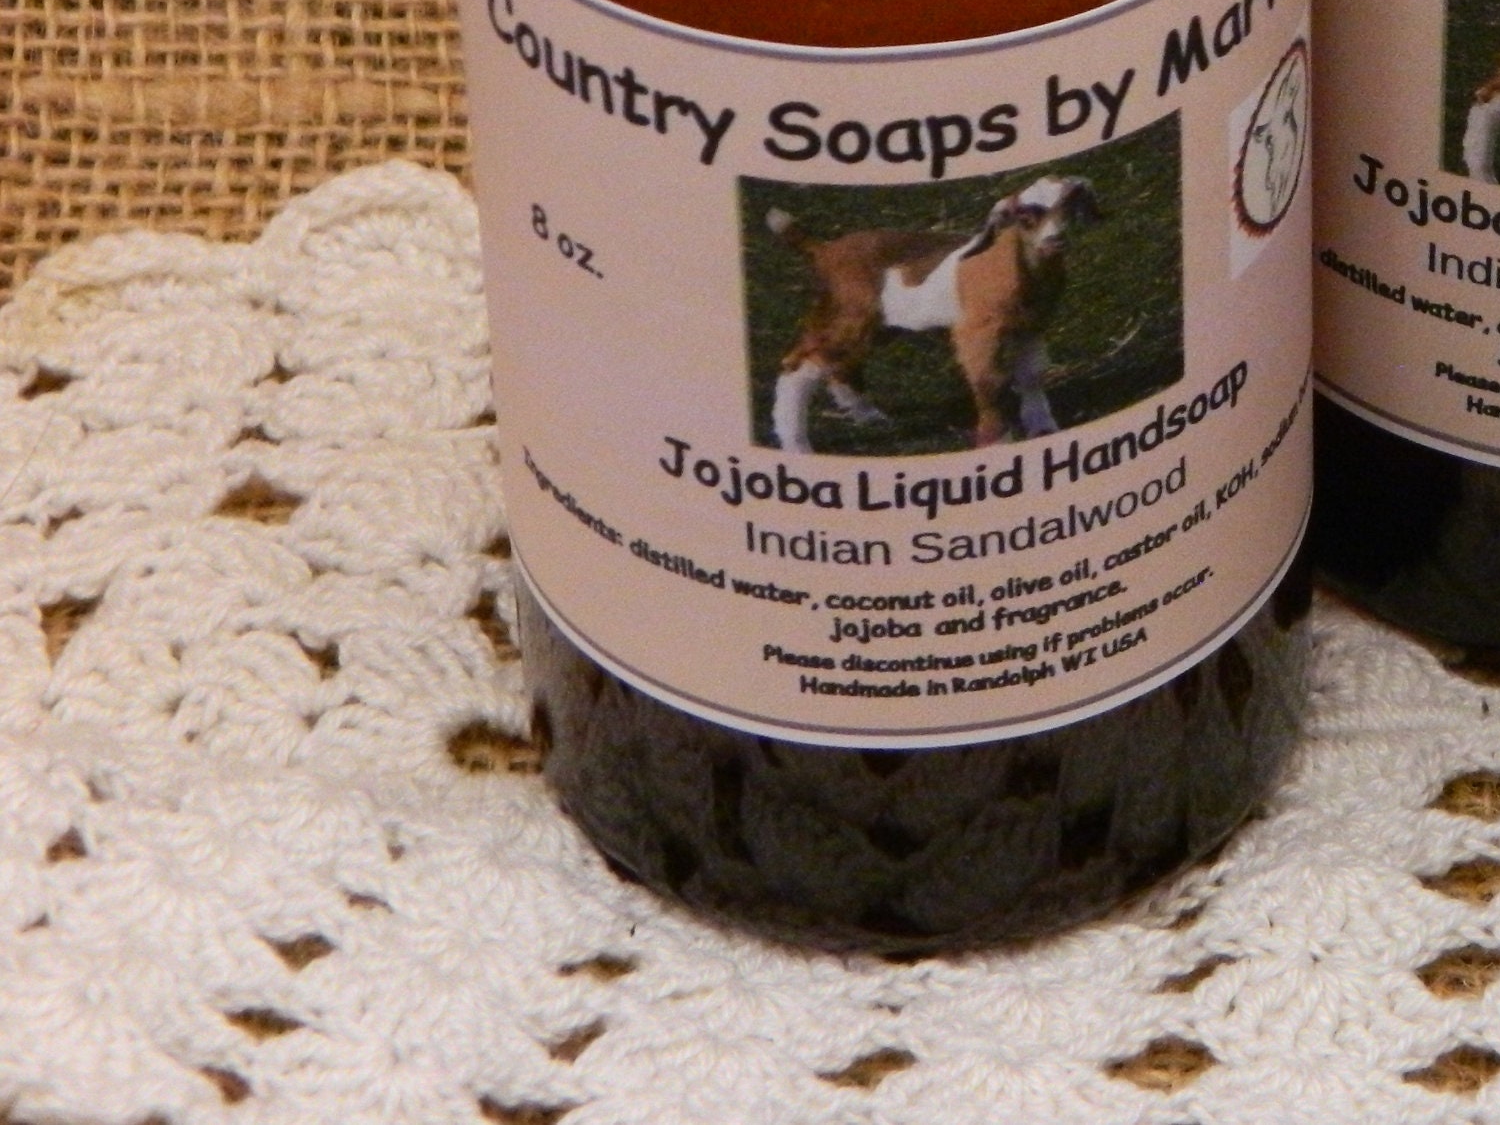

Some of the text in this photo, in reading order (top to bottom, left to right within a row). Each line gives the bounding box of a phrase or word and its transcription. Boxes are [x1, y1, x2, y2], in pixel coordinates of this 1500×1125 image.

[762, 101, 1018, 179] Soaps
[1047, 67, 1135, 140] by
[532, 203, 604, 279] 8 oz.
[658, 435, 844, 510] Jojoba
[857, 451, 1024, 520] Liquid
[1042, 359, 1249, 492] Handsoap
[629, 537, 726, 590] distilled
[731, 575, 820, 611] water,
[824, 590, 936, 611] coconut
[941, 583, 985, 608] oil,
[989, 576, 1053, 603] olive
[1059, 557, 1099, 586] oil,
[1103, 523, 1179, 572] castor
[1181, 499, 1212, 533] oil,
[745, 456, 1187, 566] Indian Sandalwood
[762, 565, 1215, 673] Please discontinue using if problems occur.
[799, 626, 1148, 698] Handmade in Randolph WI USA
[829, 579, 1129, 644] jojoba and fragrance.
